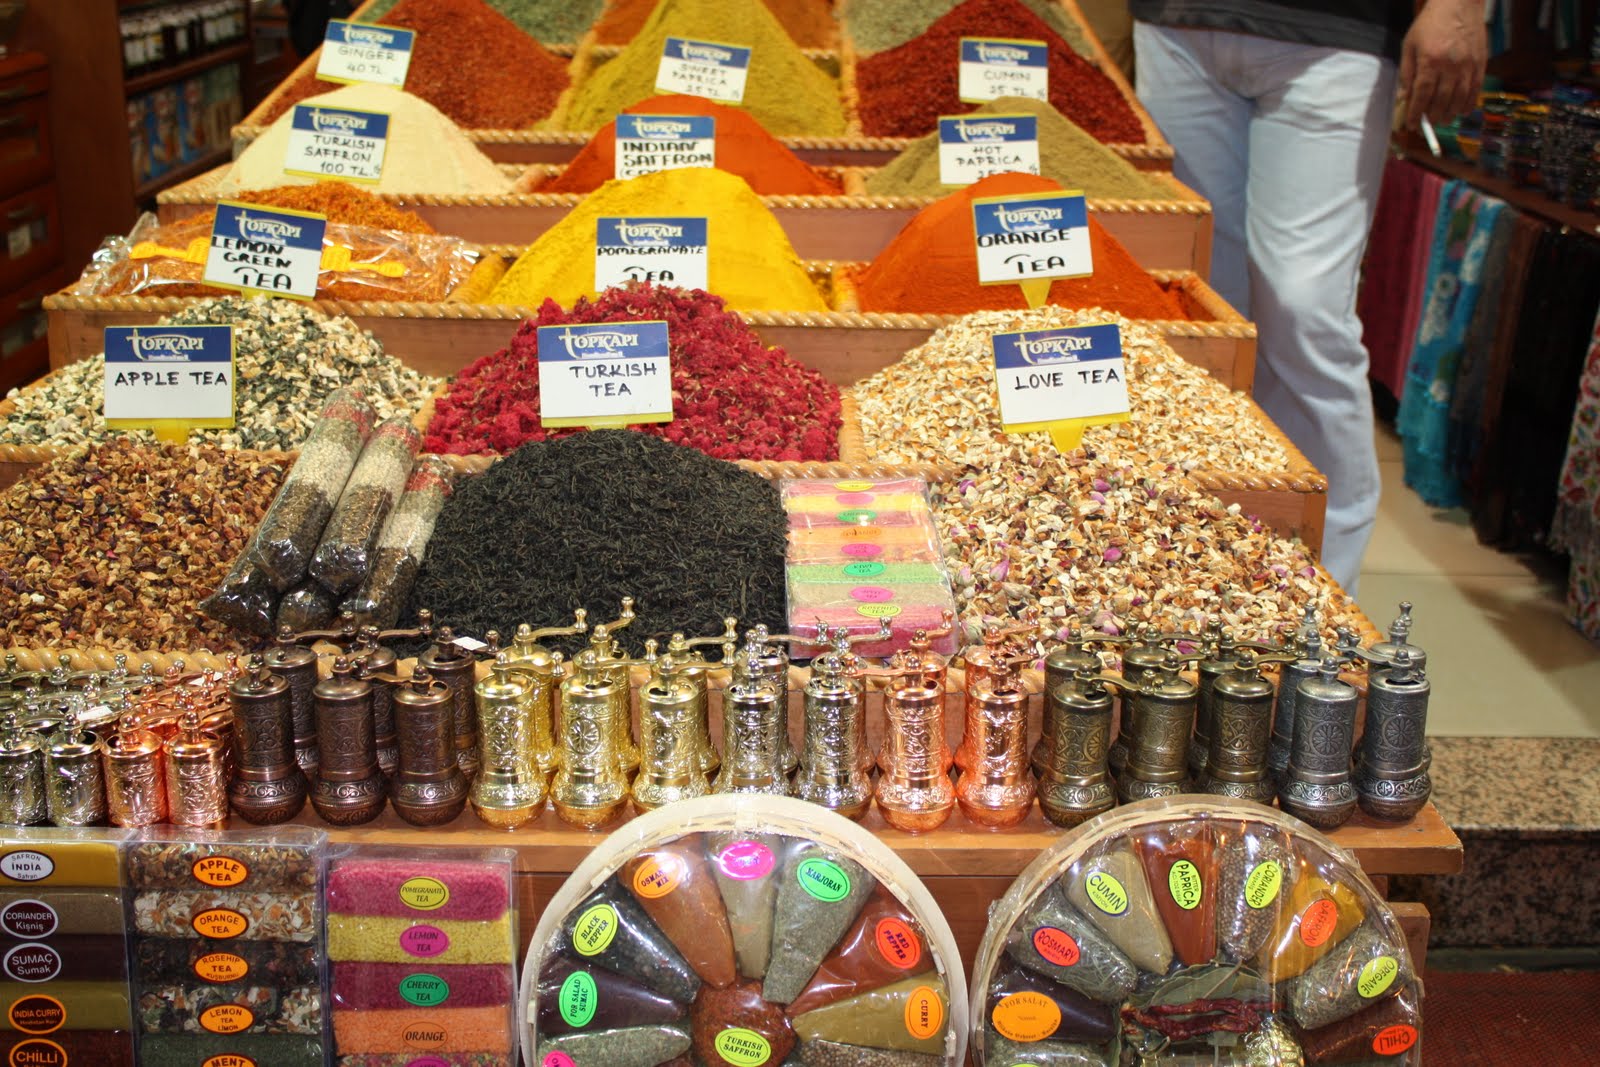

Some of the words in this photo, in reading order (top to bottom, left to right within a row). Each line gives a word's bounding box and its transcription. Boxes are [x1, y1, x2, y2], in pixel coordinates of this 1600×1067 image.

[338, 46, 394, 61] GINGER
[347, 63, 365, 73] 40
[681, 63, 726, 76] SWEET
[984, 70, 1030, 81] CUMIN
[672, 71, 727, 86] PAPRICA
[313, 134, 376, 150] TURKISH
[623, 142, 698, 153] INDIAN
[304, 145, 371, 162] SAFFRON
[973, 146, 1003, 155] HOT
[320, 161, 344, 174] 100
[624, 153, 713, 167] SAFFRON
[956, 155, 1022, 167] PAPRICA
[211, 236, 284, 255] LEMON
[977, 228, 1071, 248] ORANGE
[223, 252, 292, 268] GREEN
[1004, 253, 1065, 274] TEA
[234, 266, 292, 290] TEA
[623, 266, 674, 282] TEA
[569, 362, 657, 379] TURKISH
[114, 371, 180, 387] APPLE
[189, 371, 228, 386] TEA
[1014, 372, 1064, 390] LOVE
[1077, 368, 1120, 384] TEA
[588, 382, 632, 397] TEA
[11, 853, 41, 861] SAFRON
[200, 860, 239, 873] APPLE
[208, 873, 232, 881] TEA
[656, 876, 669, 888] MIX
[402, 886, 442, 894] POMEGRANATE
[1176, 864, 1196, 907] PAPRICA
[1249, 864, 1278, 906] CORIANDER
[1090, 875, 1125, 911] CUMIN
[200, 914, 239, 925] ORANGE
[1305, 902, 1329, 945] SAFFRON
[581, 915, 600, 940] BLACK
[587, 919, 609, 947] PEPPER
[409, 931, 439, 940] LEMON
[896, 932, 909, 949] RED
[417, 944, 431, 952] TEA
[884, 930, 906, 960] PEPPER
[1038, 931, 1077, 962] ROSMARY
[12, 953, 53, 967] SUMAÇ
[202, 954, 241, 964] ROSEHIP
[17, 965, 51, 975] Sumak
[1361, 960, 1395, 994] OREGANE
[407, 981, 440, 990] CHERRY
[572, 979, 580, 1003] SALAD
[416, 993, 431, 1001] TEA
[579, 988, 588, 1012] SUMAC
[1005, 998, 1021, 1008] FOR
[1023, 997, 1048, 1008] SALAT
[35, 1008, 61, 1017] CURRY
[210, 1008, 242, 1018] LEMON
[920, 1000, 928, 1028] CURRY
[405, 1031, 445, 1041] ORANGE
[726, 1035, 763, 1051] TURKISH
[1380, 1031, 1410, 1051] CHILI
[723, 1044, 762, 1058] SAFFRON
[211, 1057, 246, 1067] MENT
